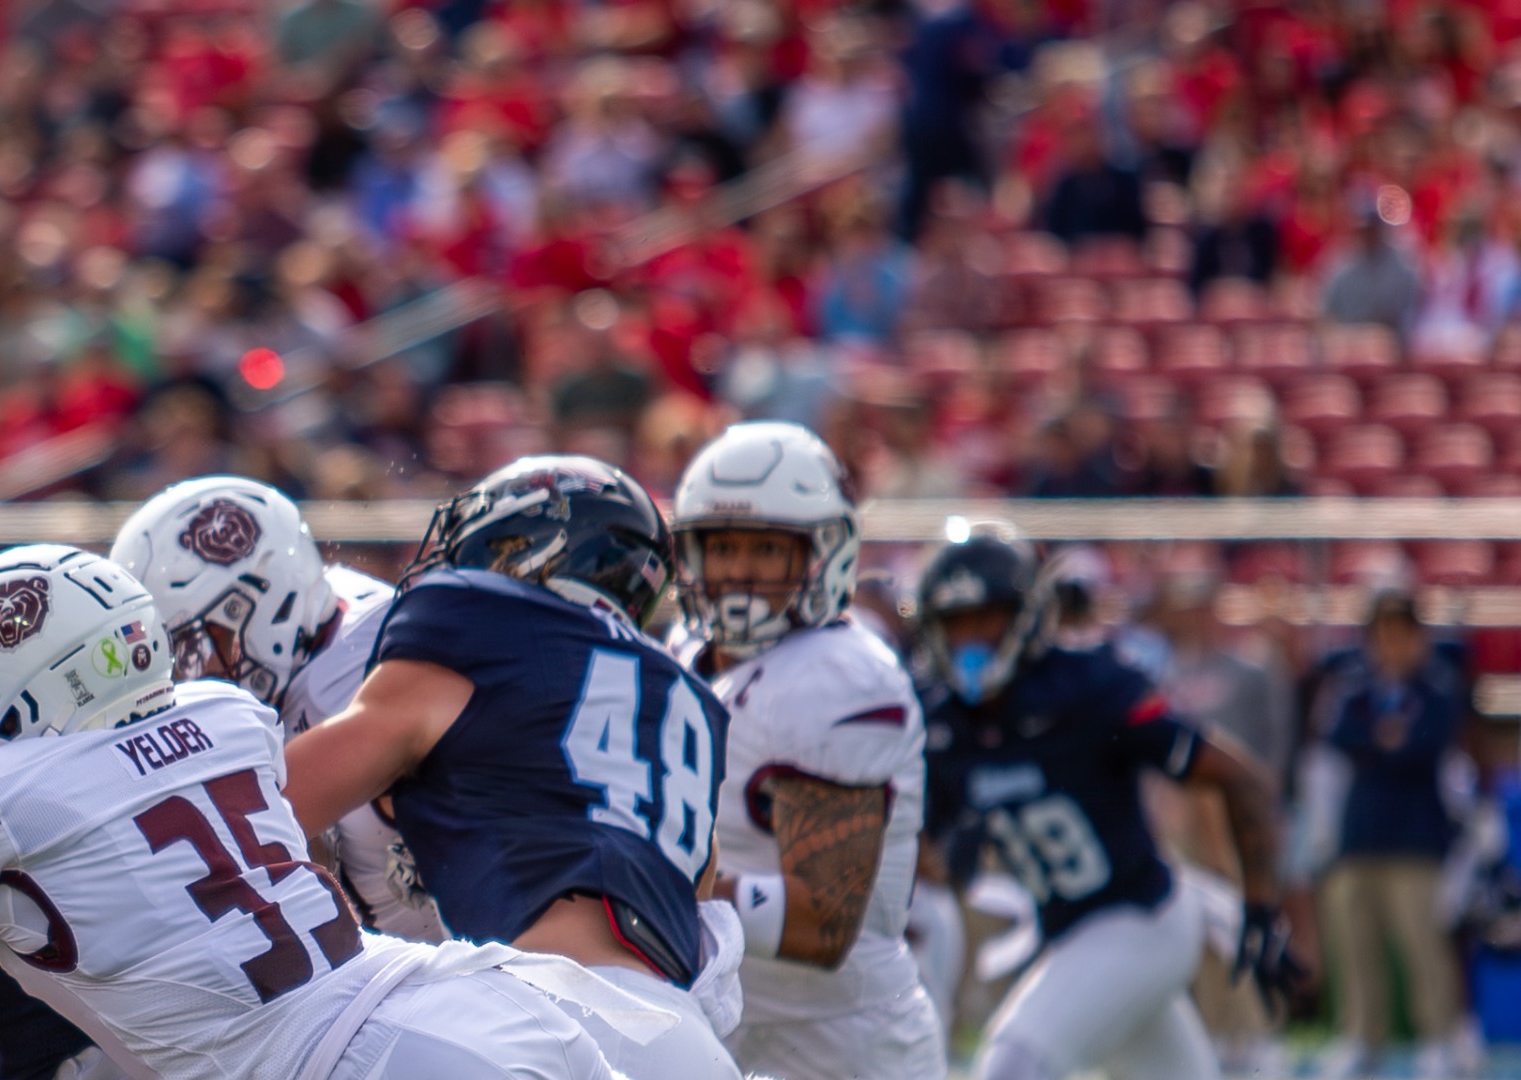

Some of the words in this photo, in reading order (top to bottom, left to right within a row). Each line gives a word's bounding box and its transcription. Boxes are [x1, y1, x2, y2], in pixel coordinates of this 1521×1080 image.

[115, 718, 214, 776] YELDER
[561, 648, 715, 884] 48
[133, 767, 364, 1005] 35
